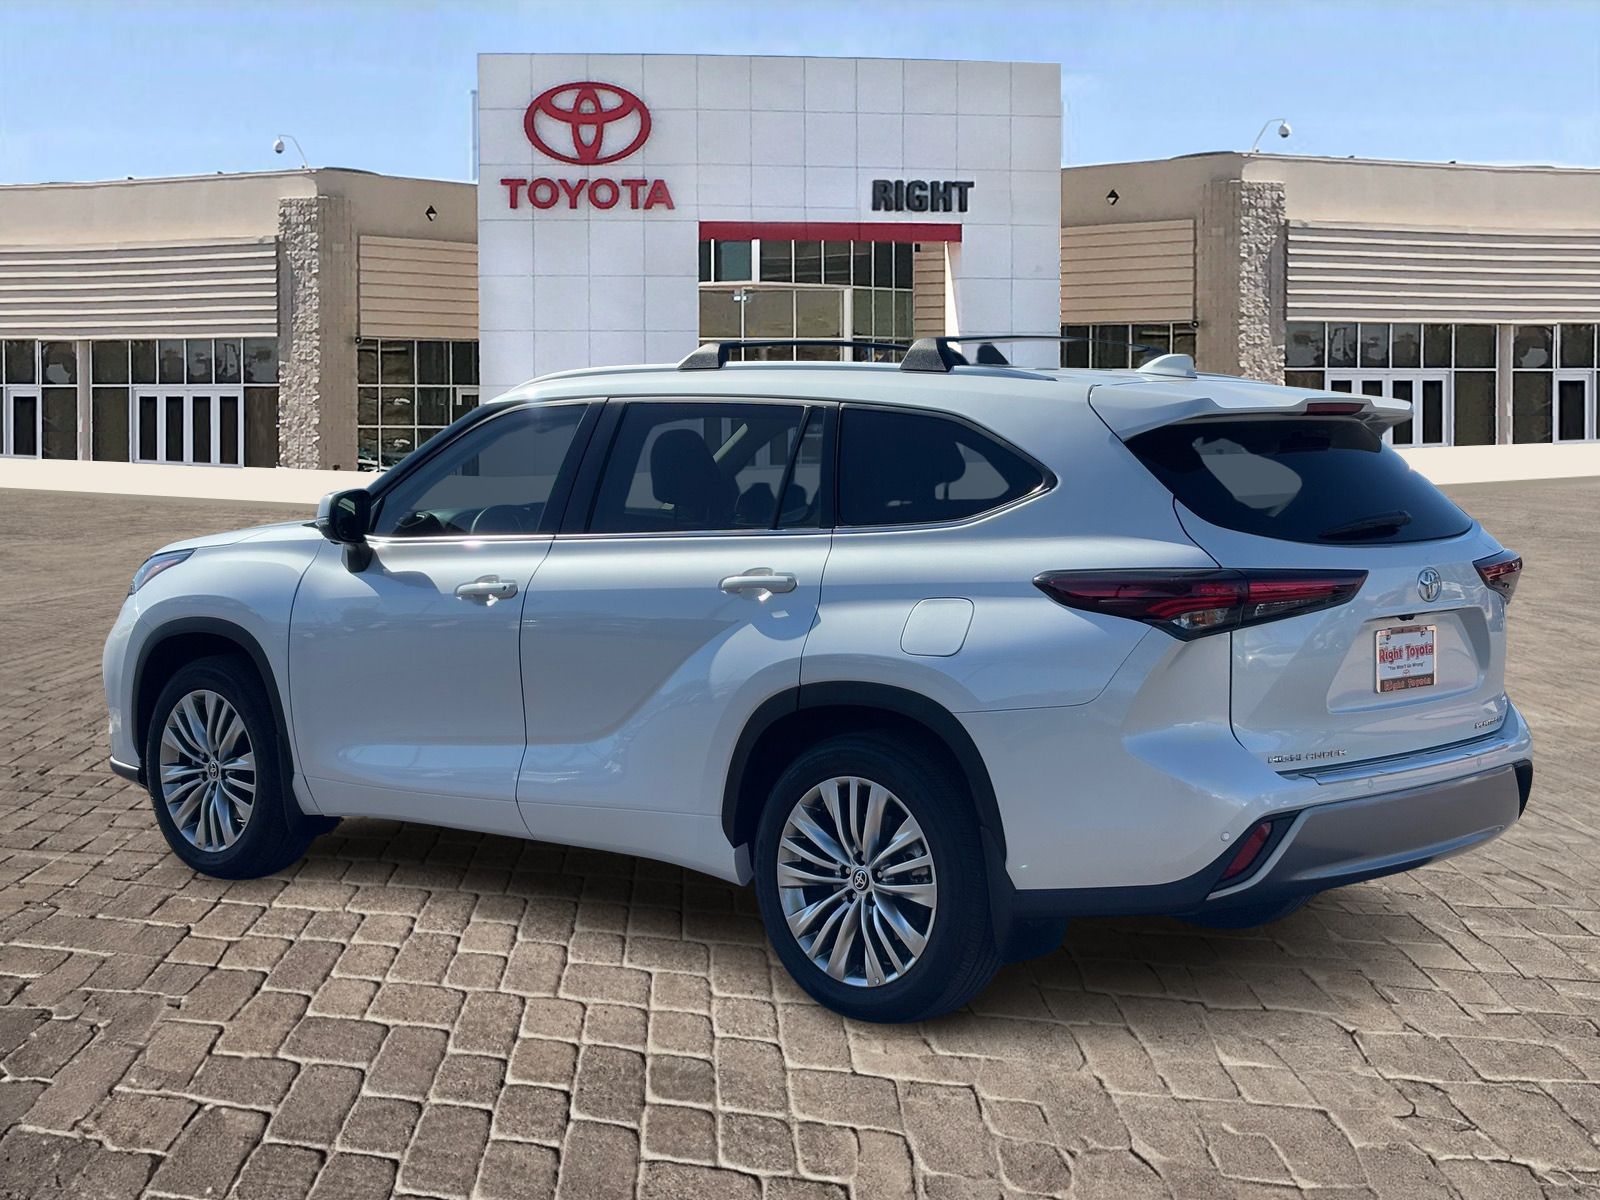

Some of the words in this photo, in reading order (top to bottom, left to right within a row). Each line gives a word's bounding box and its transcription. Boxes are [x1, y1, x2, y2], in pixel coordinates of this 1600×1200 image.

[500, 178, 675, 209] TOYOTA
[872, 179, 975, 212] RIGHT
[1379, 646, 1403, 664] Right
[1405, 643, 1433, 660] Toyota
